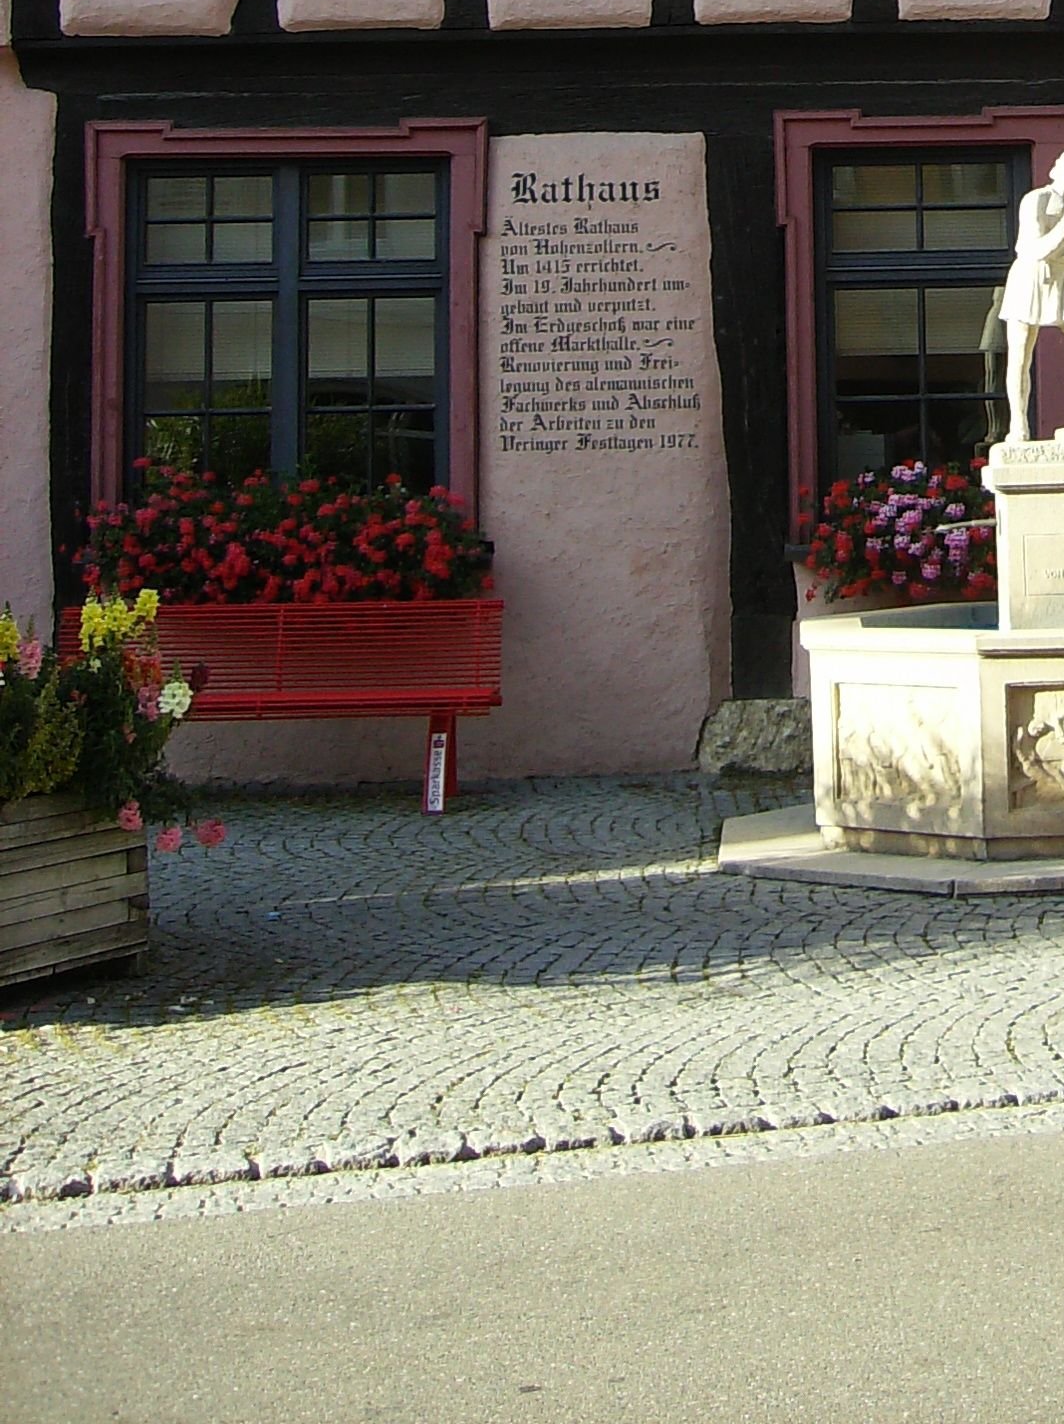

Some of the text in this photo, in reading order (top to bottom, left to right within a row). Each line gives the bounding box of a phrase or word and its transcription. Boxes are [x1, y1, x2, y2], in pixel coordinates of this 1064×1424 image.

[511, 173, 661, 210] Rathaus
[501, 216, 639, 237] Ältestes Rathaus
[500, 239, 643, 259] von Hohenzollern.
[501, 258, 644, 275] Um 1415 errichtet.
[500, 278, 528, 295] Im
[534, 279, 556, 294] 19.
[560, 277, 657, 296] Jahrhundert
[500, 298, 656, 317] gebaut und verputzt.
[500, 317, 528, 335] Im
[632, 318, 660, 333] war
[666, 317, 695, 331] eine
[500, 334, 641, 354] offene Markthalle.
[499, 356, 599, 375] Renovierung
[604, 356, 632, 371] und
[500, 375, 694, 396] legung des alemannischen
[500, 394, 586, 413] Fachwerks
[592, 396, 619, 412] und
[499, 413, 656, 432] der Arbeiten zu den
[499, 433, 699, 454] Veringer Festtagen 1977.
[430, 750, 442, 806] Sparkasse
